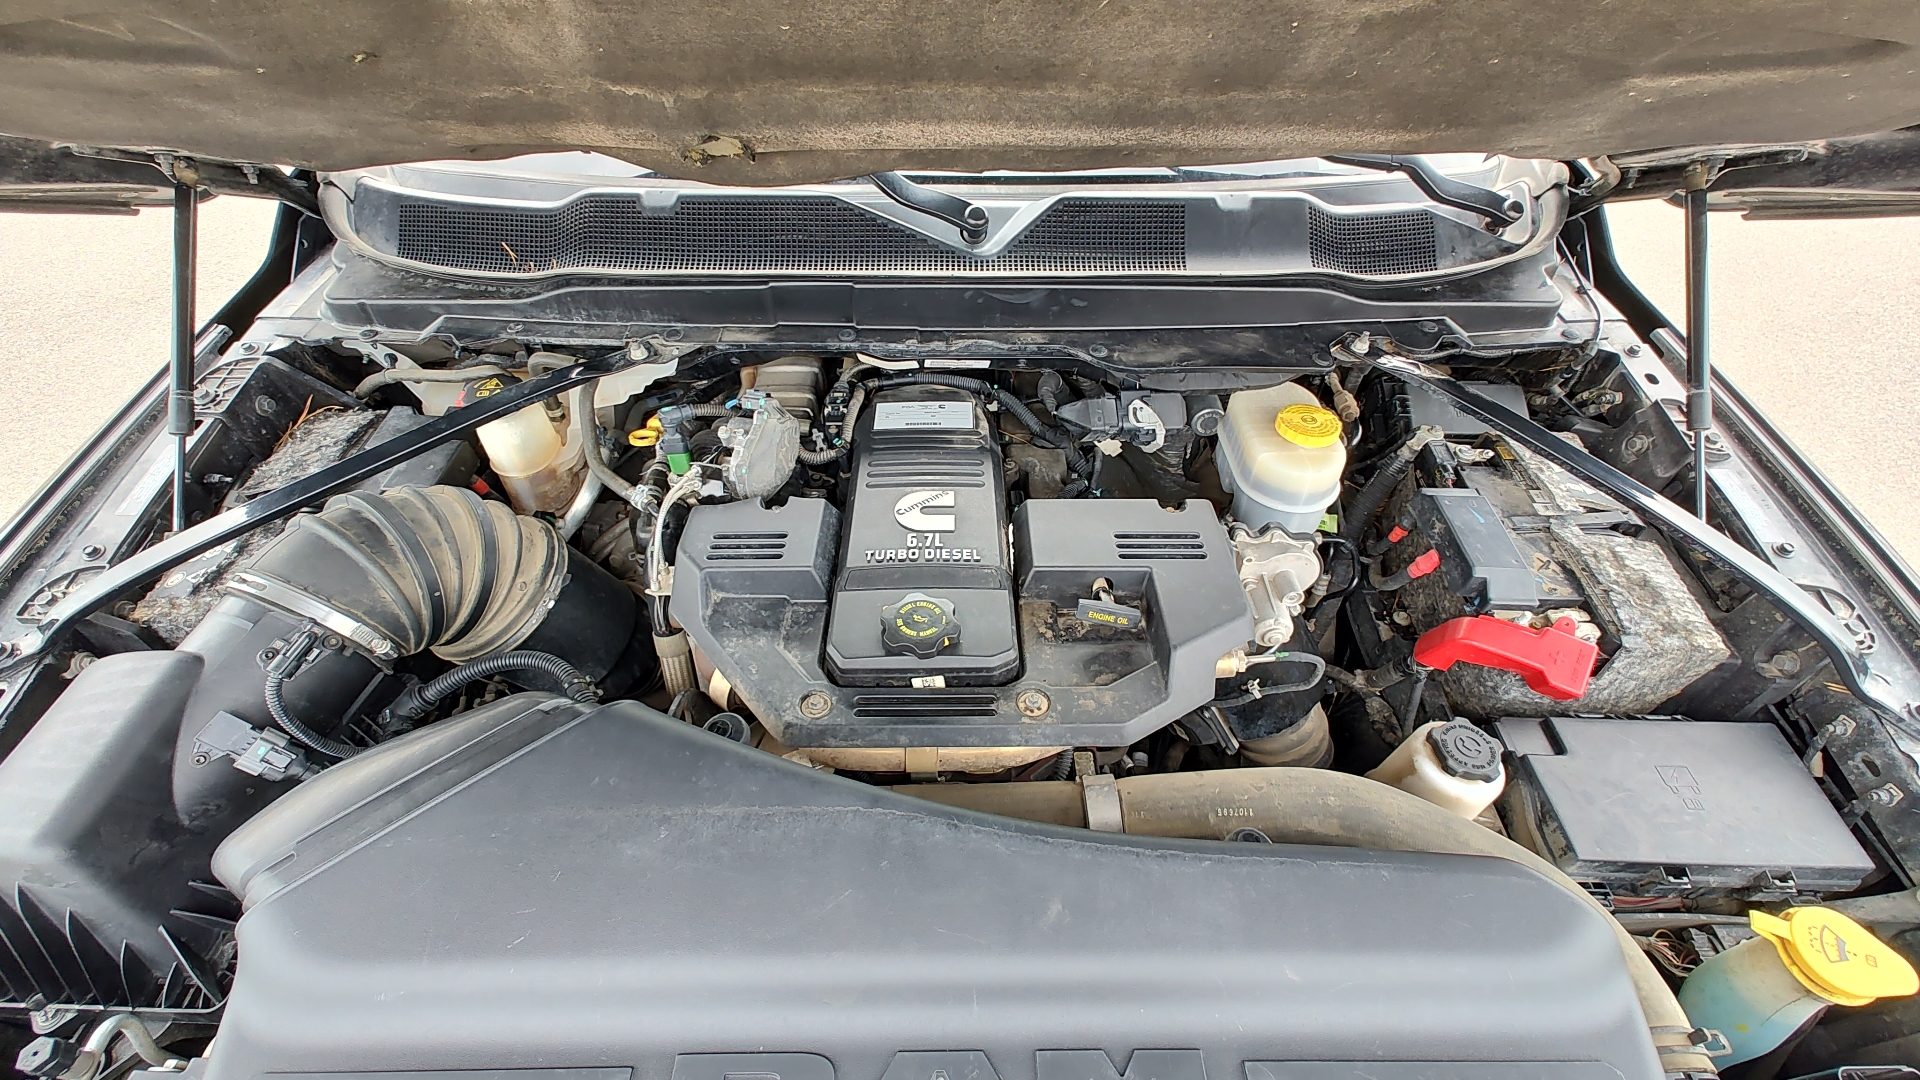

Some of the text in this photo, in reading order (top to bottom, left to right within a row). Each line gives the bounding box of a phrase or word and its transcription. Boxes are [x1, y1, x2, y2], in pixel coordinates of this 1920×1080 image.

[895, 490, 950, 516] Cummins
[906, 532, 944, 548] 6.7L
[865, 548, 982, 563] TURBO DIESEL
[1088, 610, 1129, 625] ENGINE OIL
